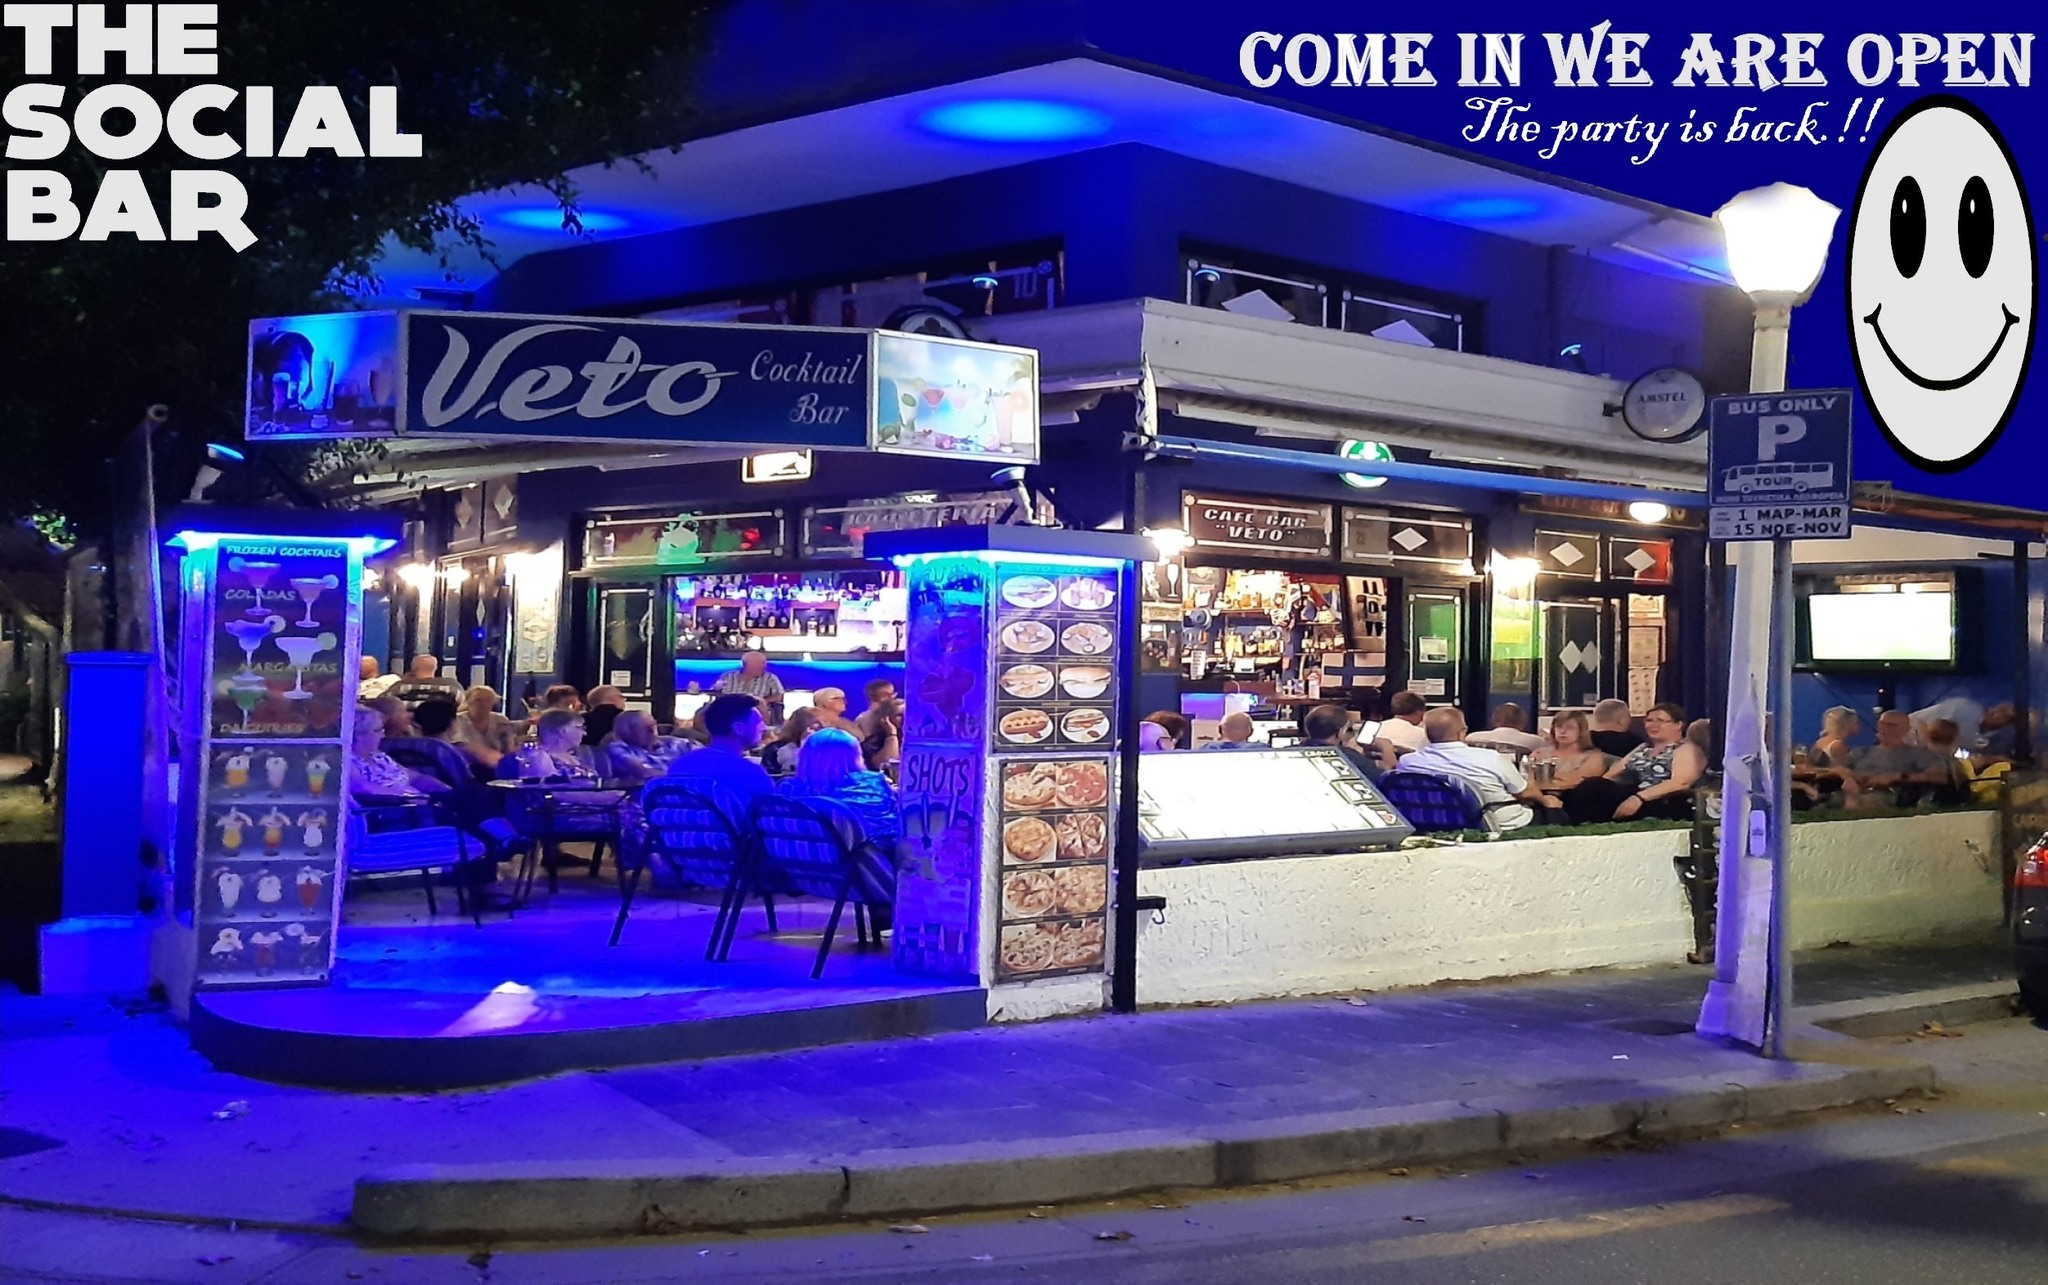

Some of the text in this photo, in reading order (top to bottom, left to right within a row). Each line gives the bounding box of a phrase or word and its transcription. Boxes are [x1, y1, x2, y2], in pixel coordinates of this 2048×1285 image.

[422, 323, 862, 428] Veto Cocktail
[1639, 391, 1687, 403] AMSTEL
[789, 393, 851, 426] Bar
[1728, 396, 1837, 415] BUS ONLY
[1758, 415, 1807, 461] P
[1754, 476, 1793, 487] TOUR
[1738, 508, 1748, 521] 1
[1734, 523, 1755, 536] 15
[226, 545, 342, 558] FROZEN COCKTAILS
[225, 588, 297, 601] COLADAS
[906, 753, 970, 797] SHOTS
